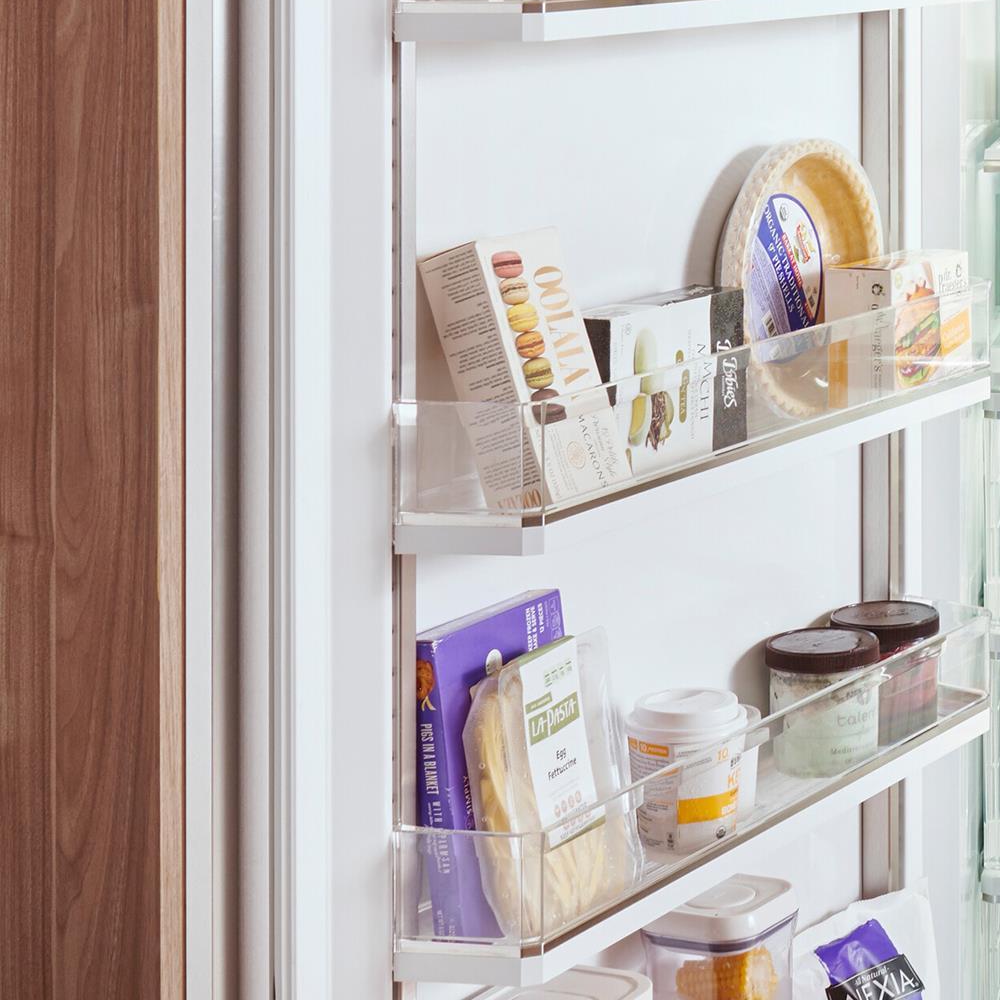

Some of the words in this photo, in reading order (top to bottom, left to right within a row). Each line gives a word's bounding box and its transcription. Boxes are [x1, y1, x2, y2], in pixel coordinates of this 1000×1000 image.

[763, 205, 785, 257] ORGANIC
[533, 265, 591, 385] OOLALA
[420, 723, 435, 742] PIGS
[547, 757, 578, 781] Fettuccine
[555, 747, 567, 761] Egg
[424, 761, 440, 795] BLANKET
[846, 969, 917, 1000] EXIA
